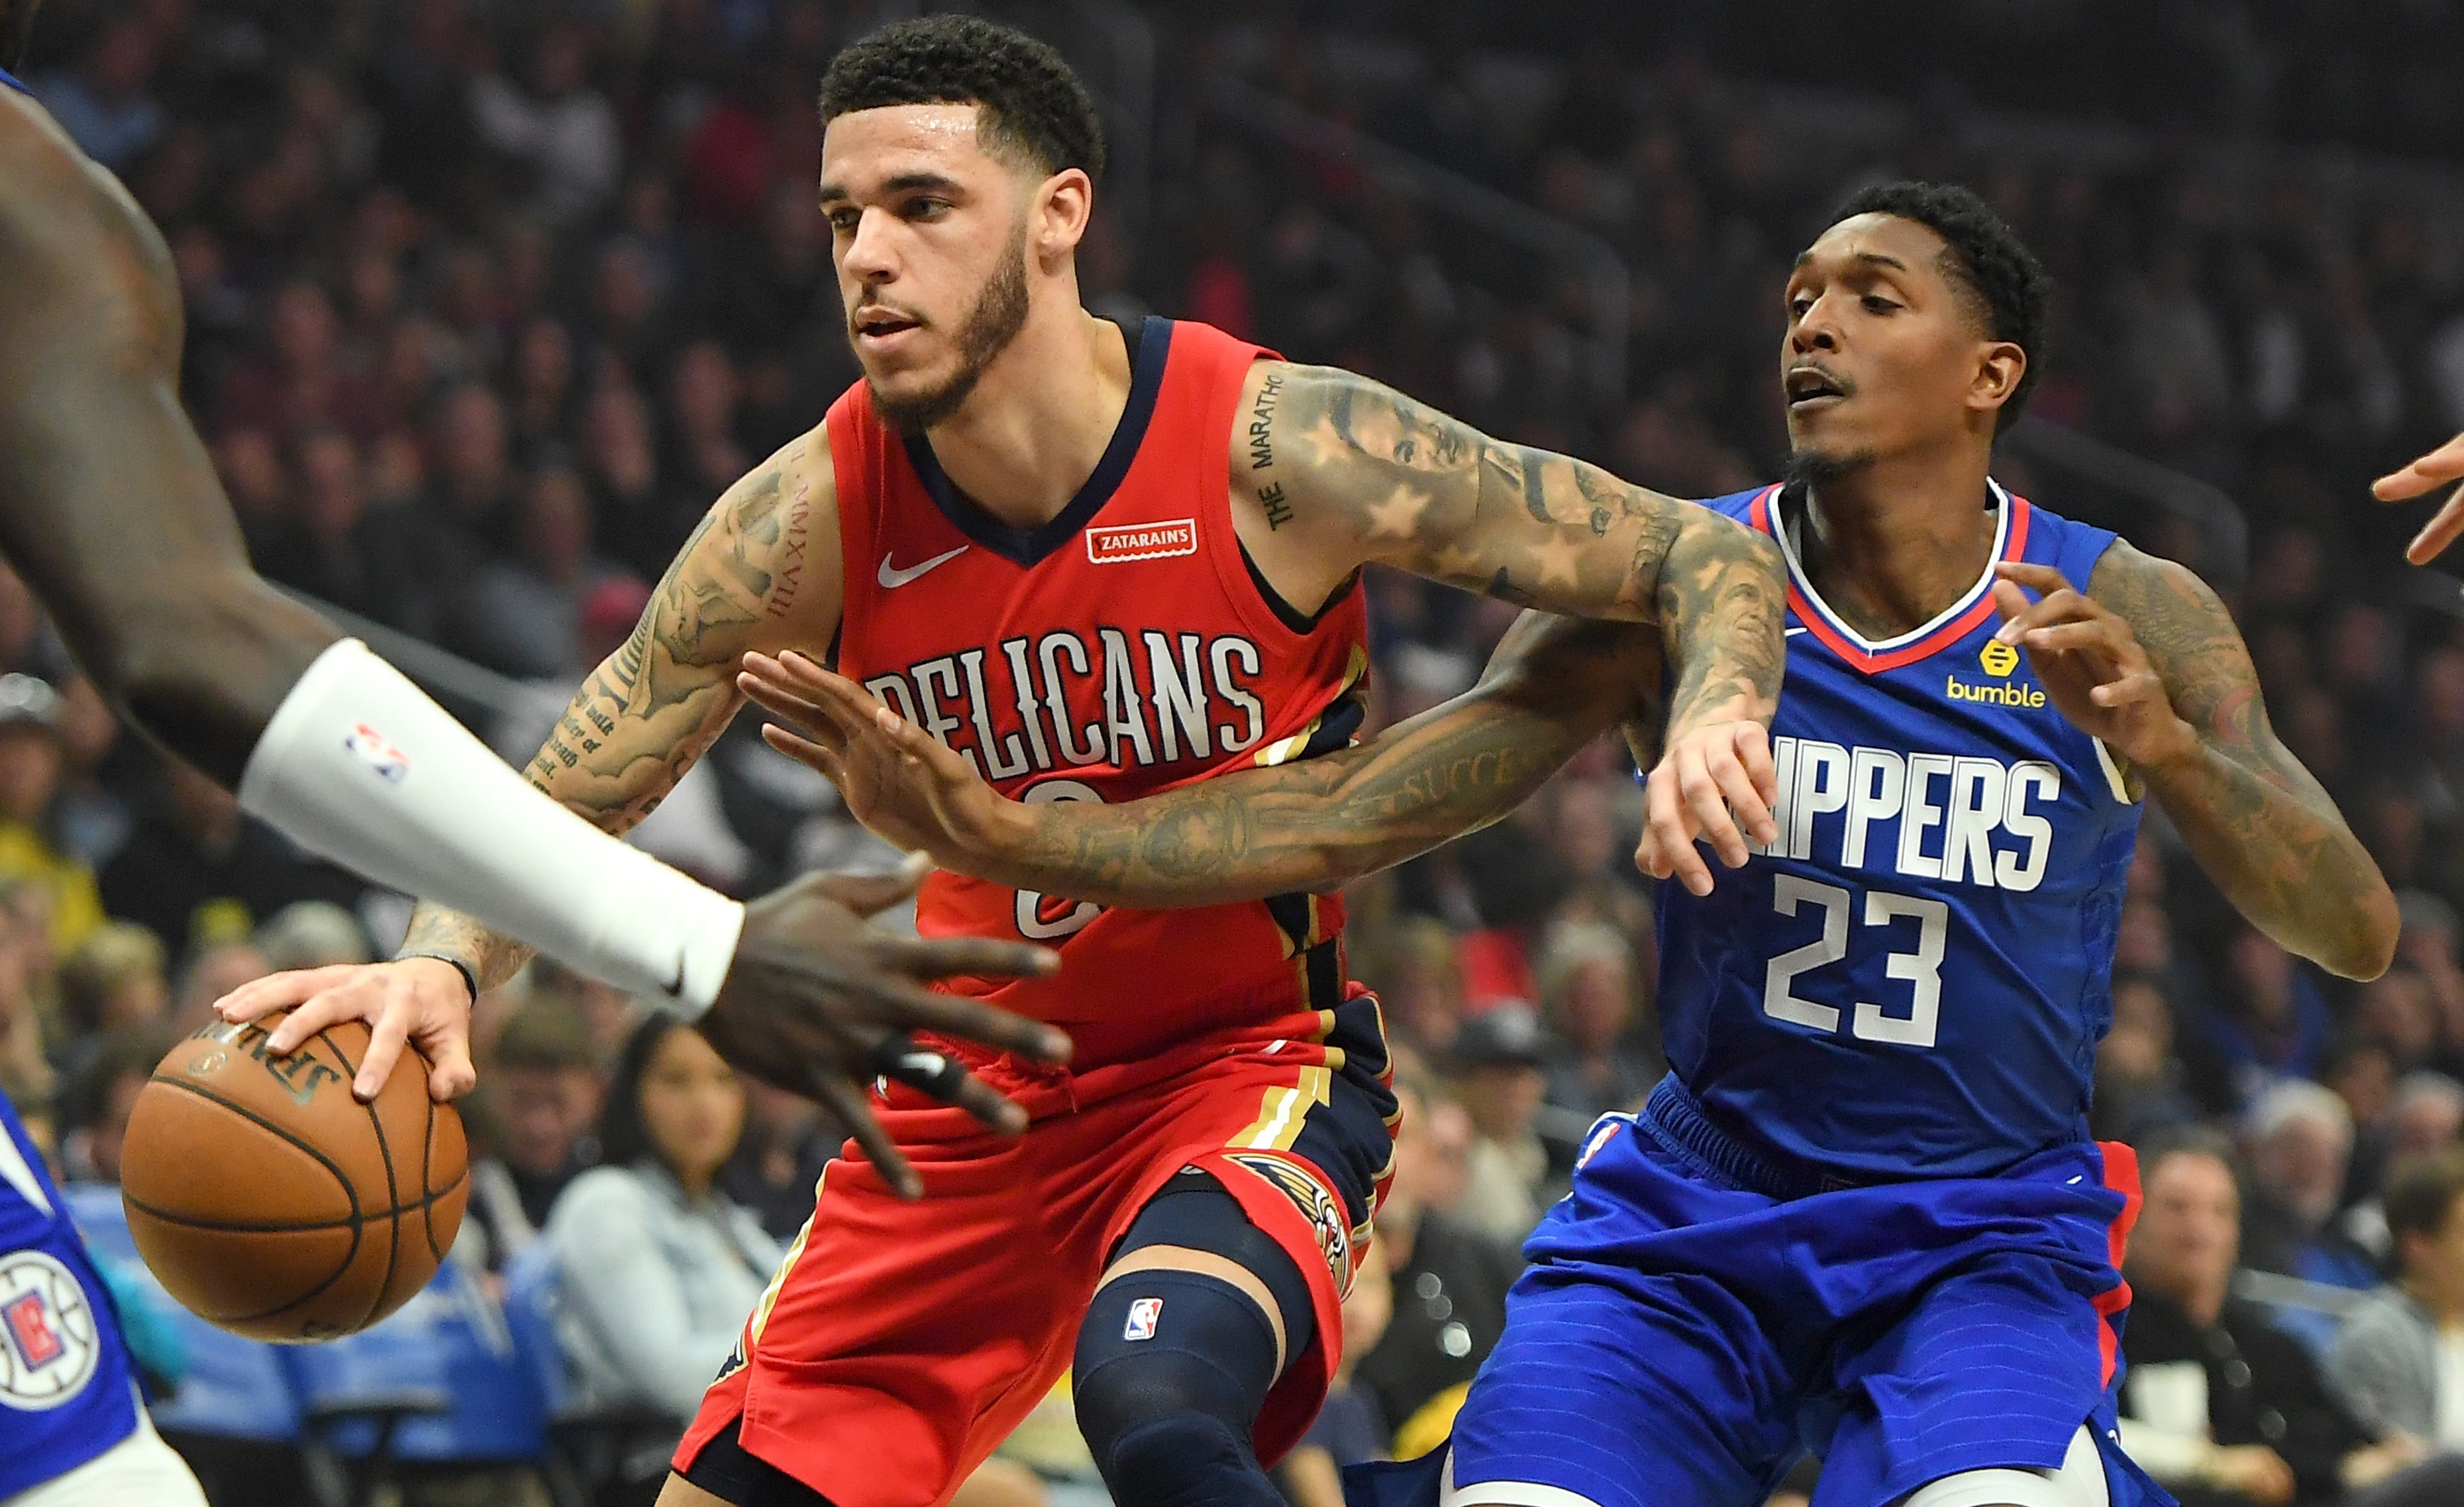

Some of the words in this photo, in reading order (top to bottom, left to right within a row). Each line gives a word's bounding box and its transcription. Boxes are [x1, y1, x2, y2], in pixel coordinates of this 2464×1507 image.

[1258, 481, 1293, 531] THE
[1946, 674, 2047, 709] bumble
[1694, 733, 2061, 893] IPPERS
[1763, 872, 1949, 1048] 23
